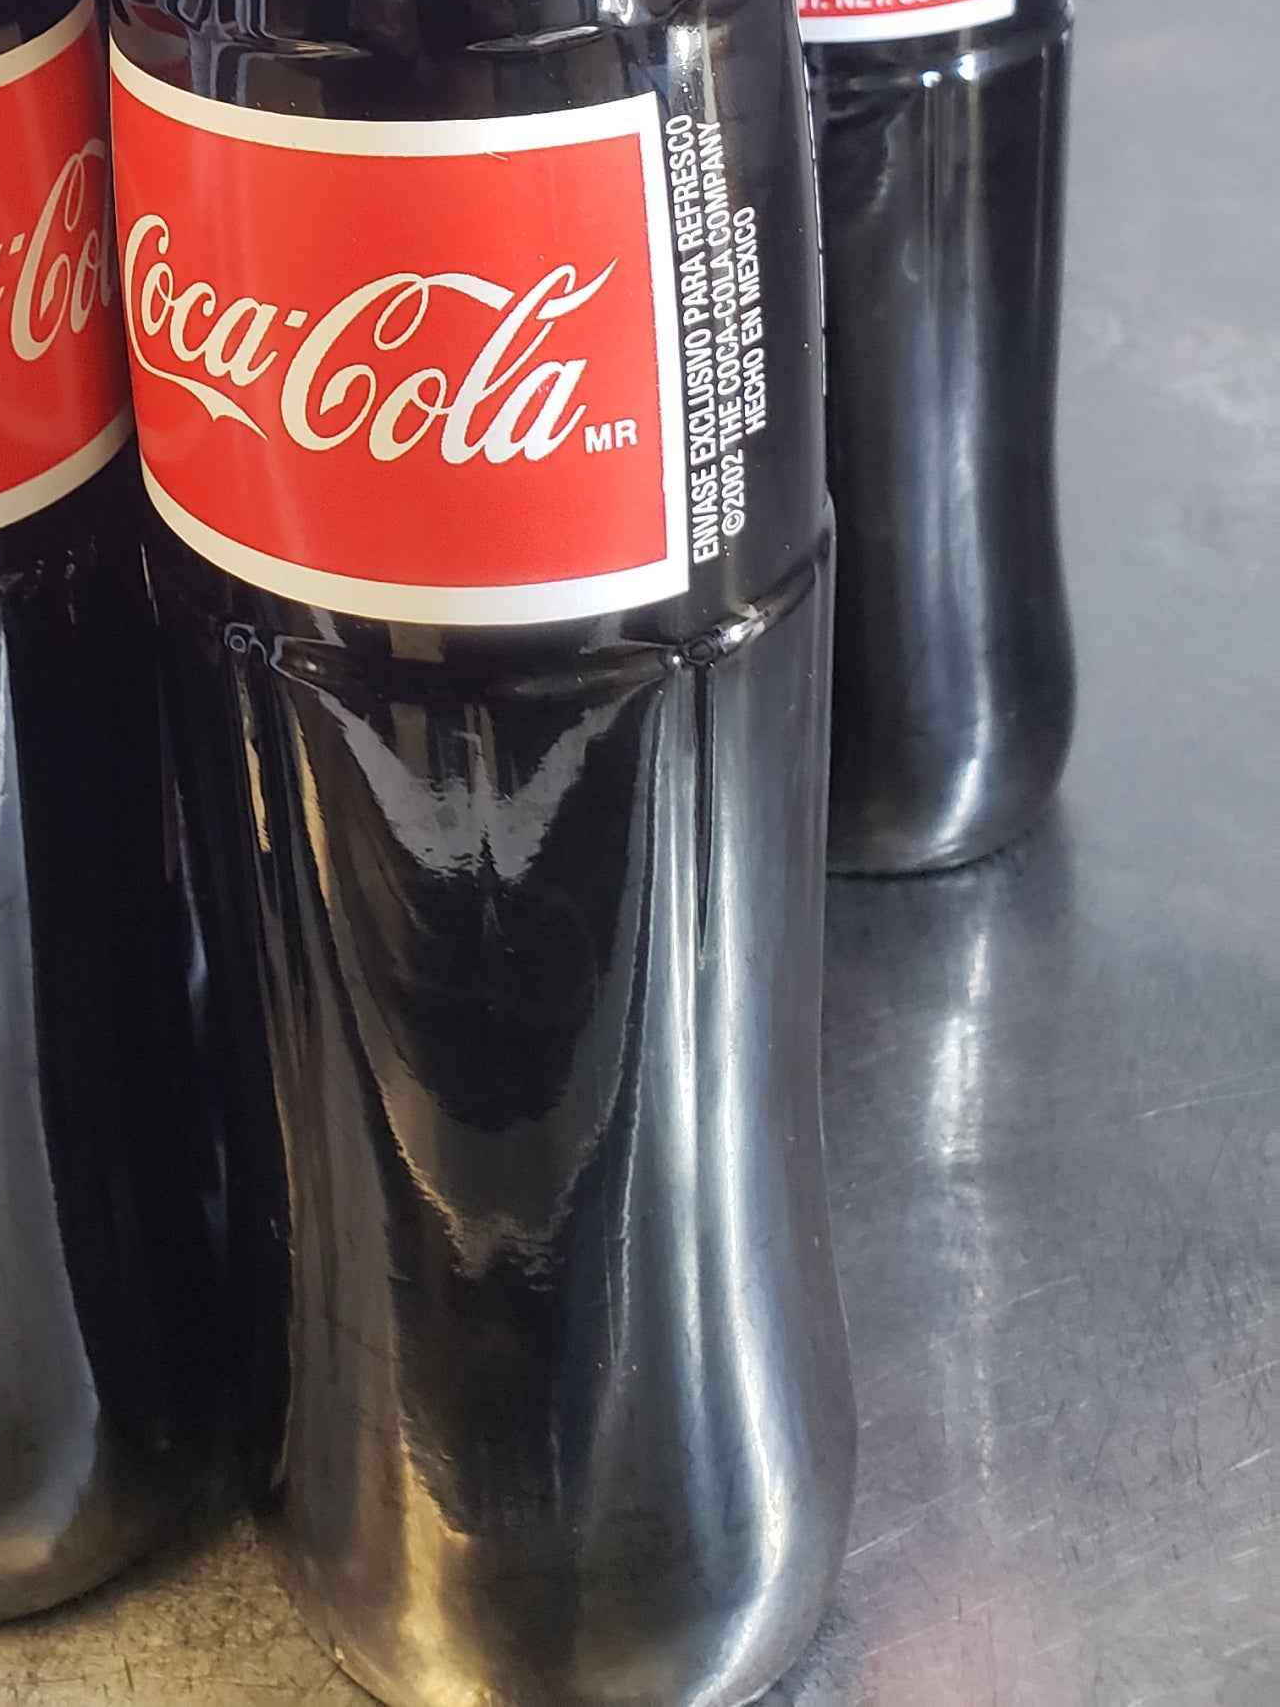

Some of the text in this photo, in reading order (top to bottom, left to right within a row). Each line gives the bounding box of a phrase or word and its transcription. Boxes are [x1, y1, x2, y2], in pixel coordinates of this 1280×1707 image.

[696, 121, 732, 247] COMPANY
[124, 214, 618, 465] Coca-Cola
[665, 113, 720, 565] ENVASE EXCLUSIVO PARA REFRESCO
[709, 247, 742, 396] COCA-COLA
[732, 205, 767, 436] HECHO EN MEXICO
[584, 418, 638, 454] MR
[718, 395, 744, 452] THE
